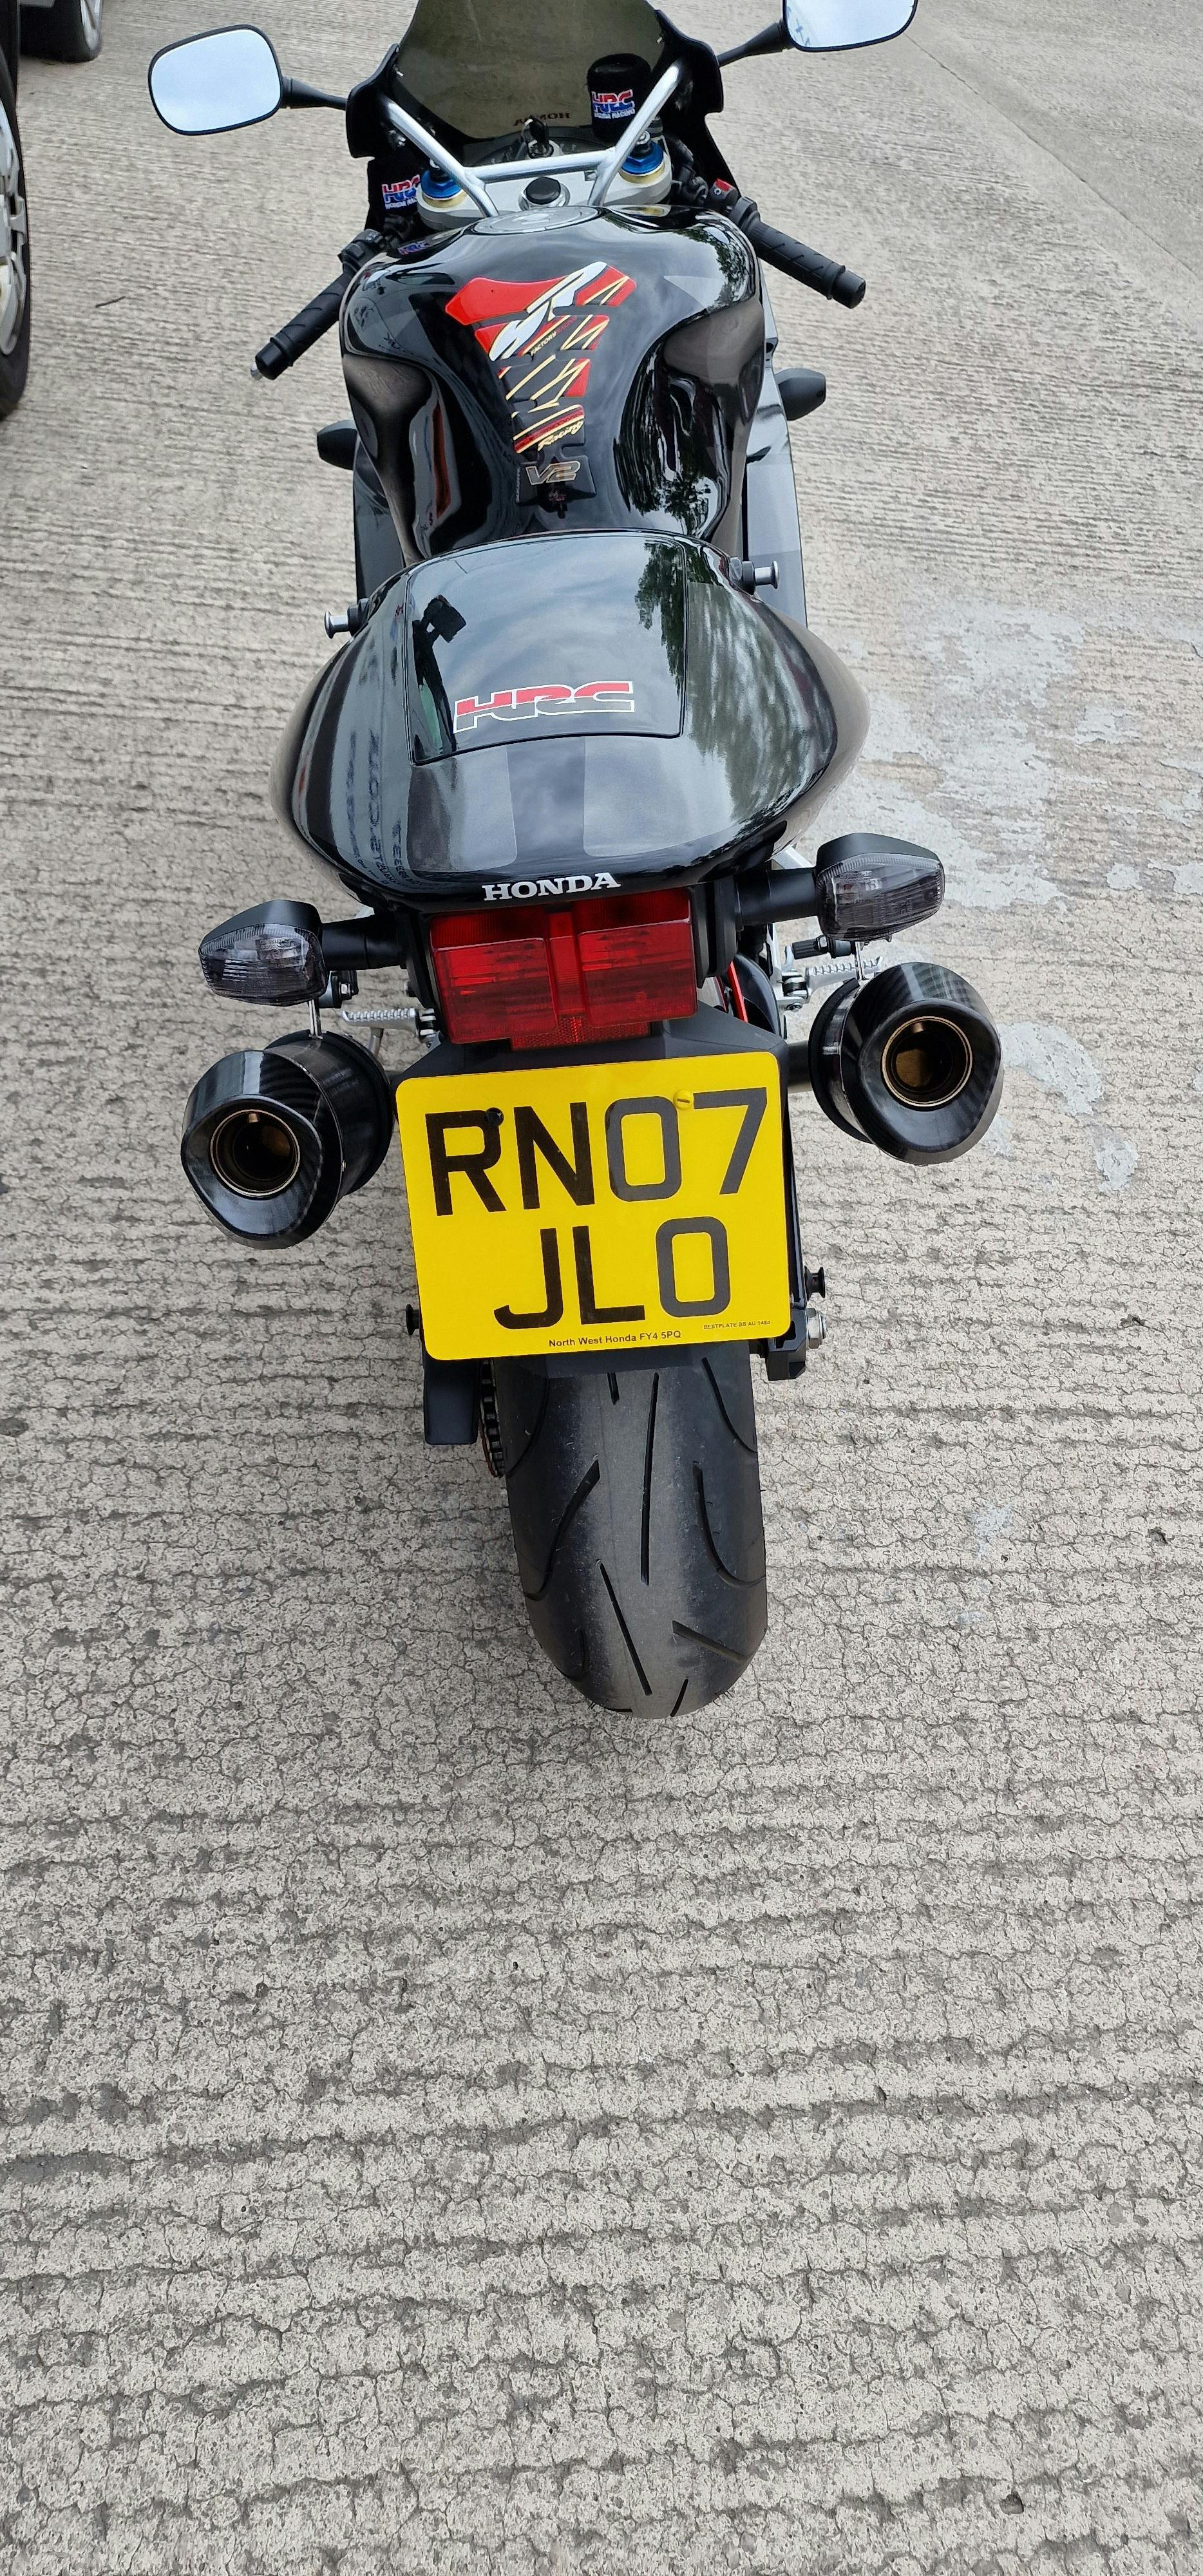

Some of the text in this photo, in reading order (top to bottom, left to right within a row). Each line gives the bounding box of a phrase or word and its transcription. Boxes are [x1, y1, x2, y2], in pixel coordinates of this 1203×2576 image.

[591, 89, 635, 113] HRC
[537, 421, 583, 451] Racing
[525, 460, 581, 486] V2
[452, 681, 635, 734] HRC
[482, 872, 621, 901] HONDA
[424, 1086, 767, 1217] RN07
[493, 1216, 731, 1331] JLO
[549, 1330, 681, 1347] North West Honda FY4 5PQ
